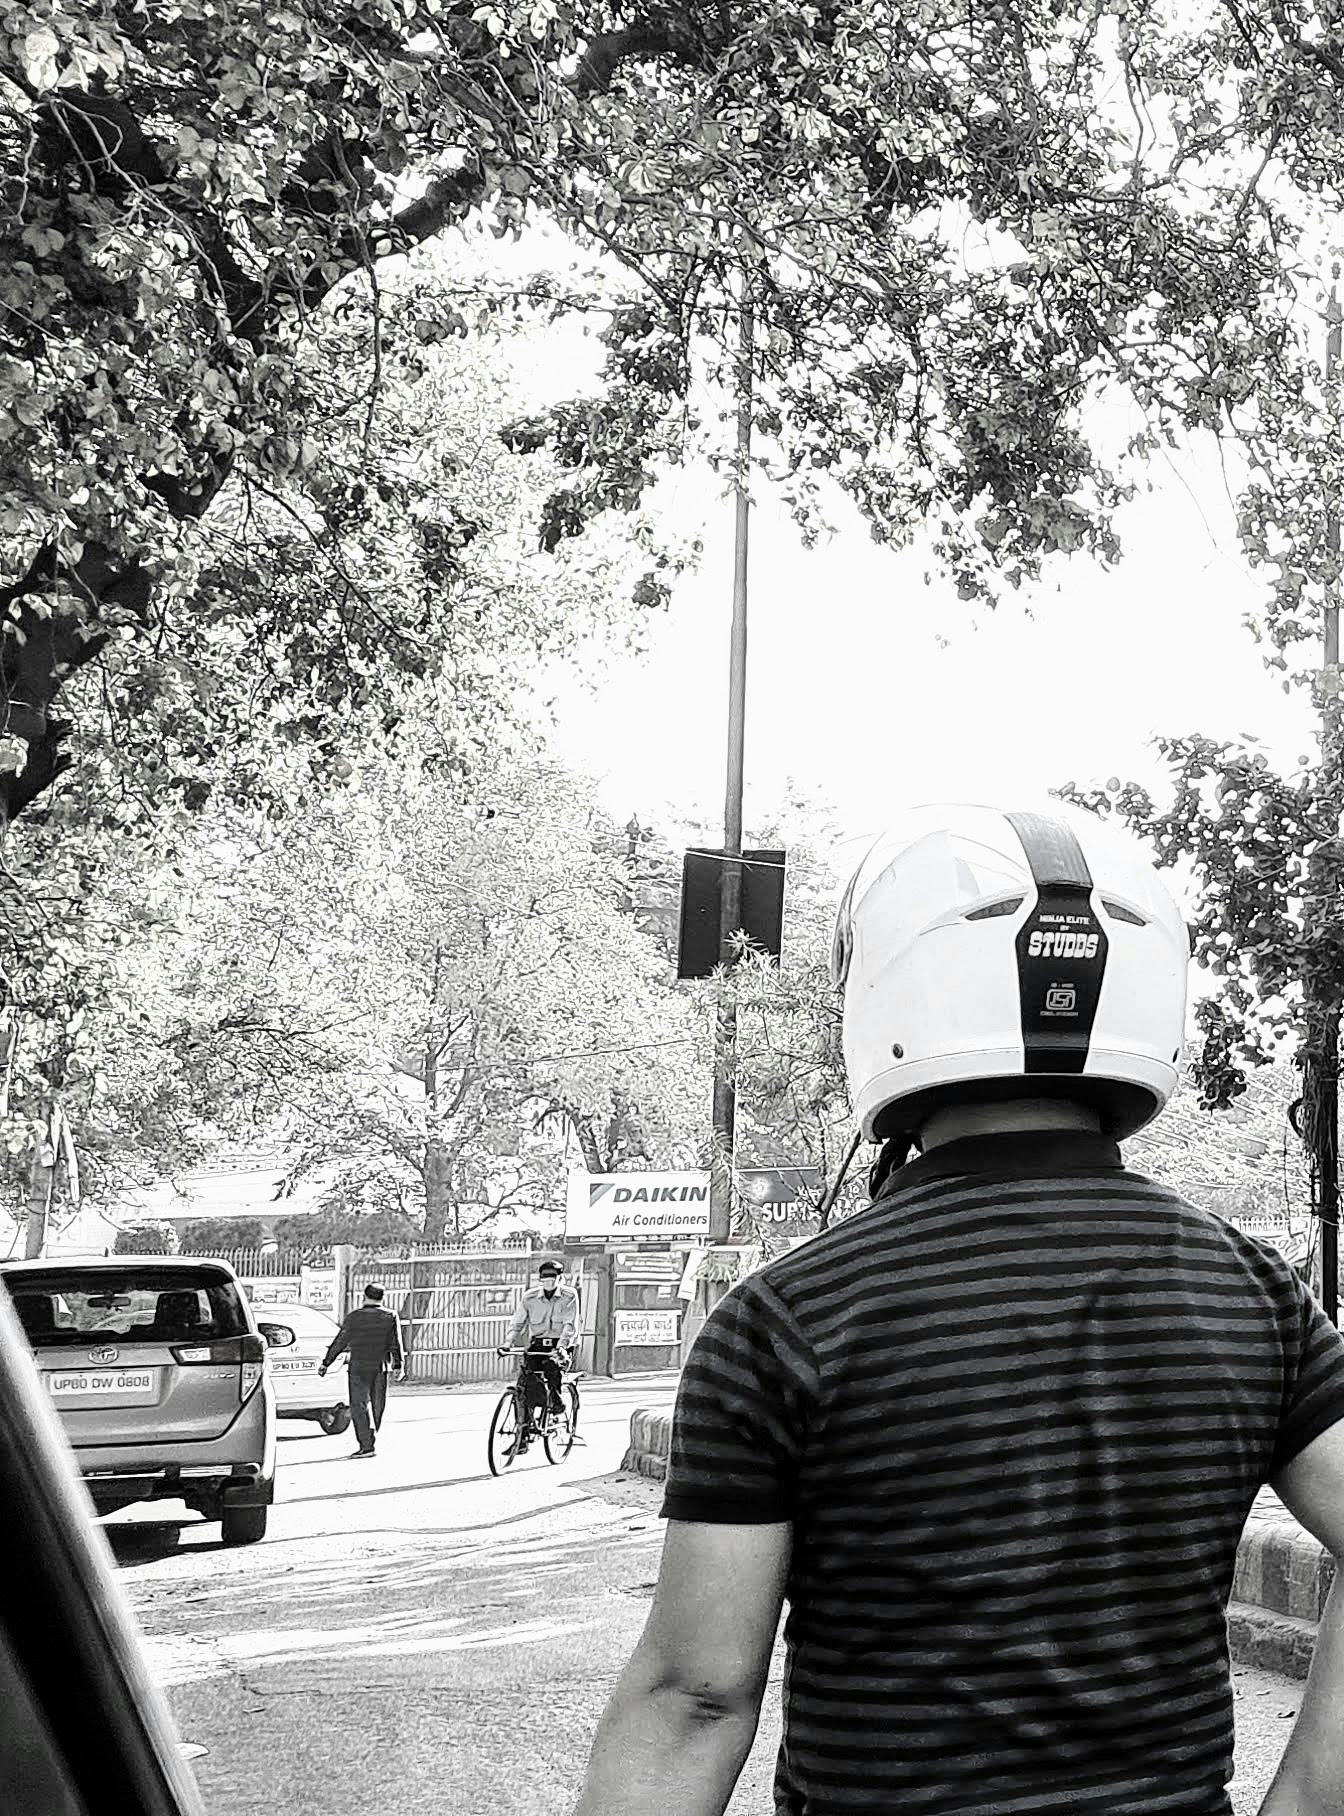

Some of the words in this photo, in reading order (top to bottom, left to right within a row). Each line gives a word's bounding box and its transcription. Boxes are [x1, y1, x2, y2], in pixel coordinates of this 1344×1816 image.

[1028, 930, 1099, 959] STUDDS
[613, 1186, 707, 1203] DAIKIN
[612, 1214, 630, 1226] Air
[633, 1213, 708, 1226] Conditioners
[91, 1376, 114, 1389] DW
